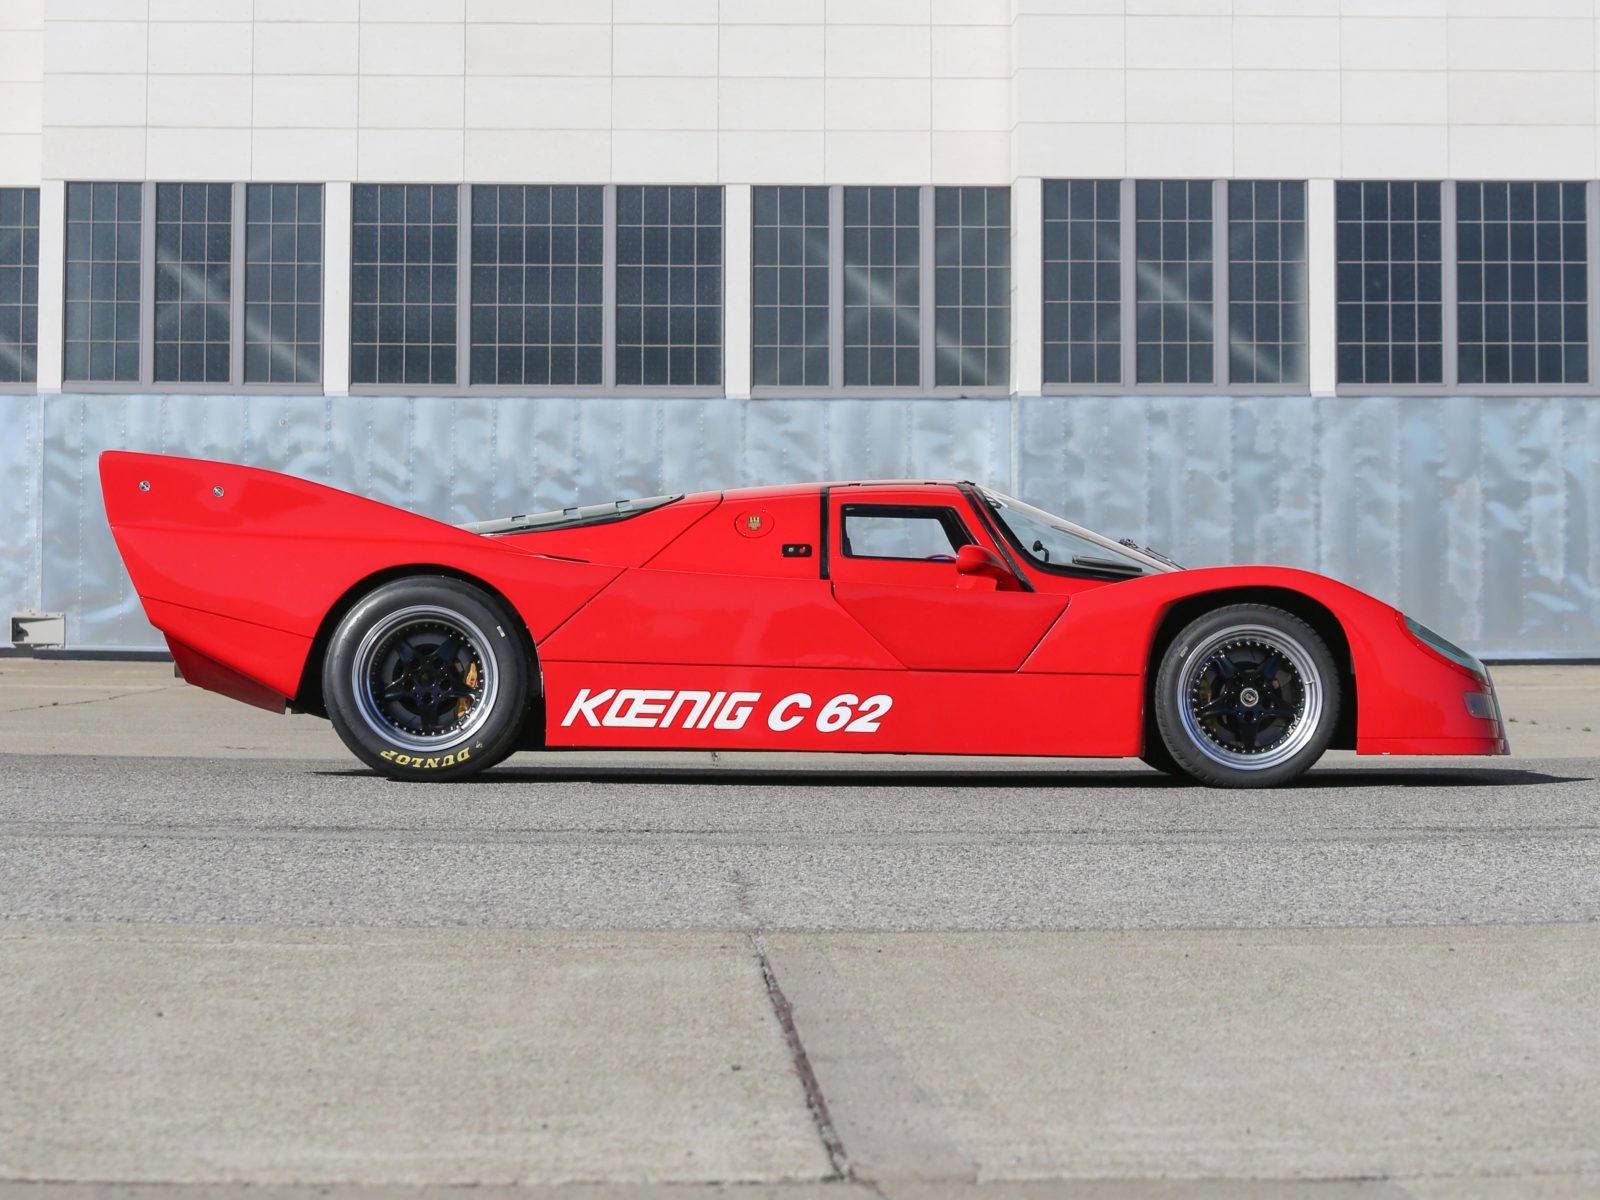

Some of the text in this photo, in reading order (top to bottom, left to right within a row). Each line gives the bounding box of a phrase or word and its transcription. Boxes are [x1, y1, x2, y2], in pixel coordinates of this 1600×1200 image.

[767, 692, 812, 731] C
[815, 693, 893, 733] 62
[380, 746, 471, 768] DUNLOP
